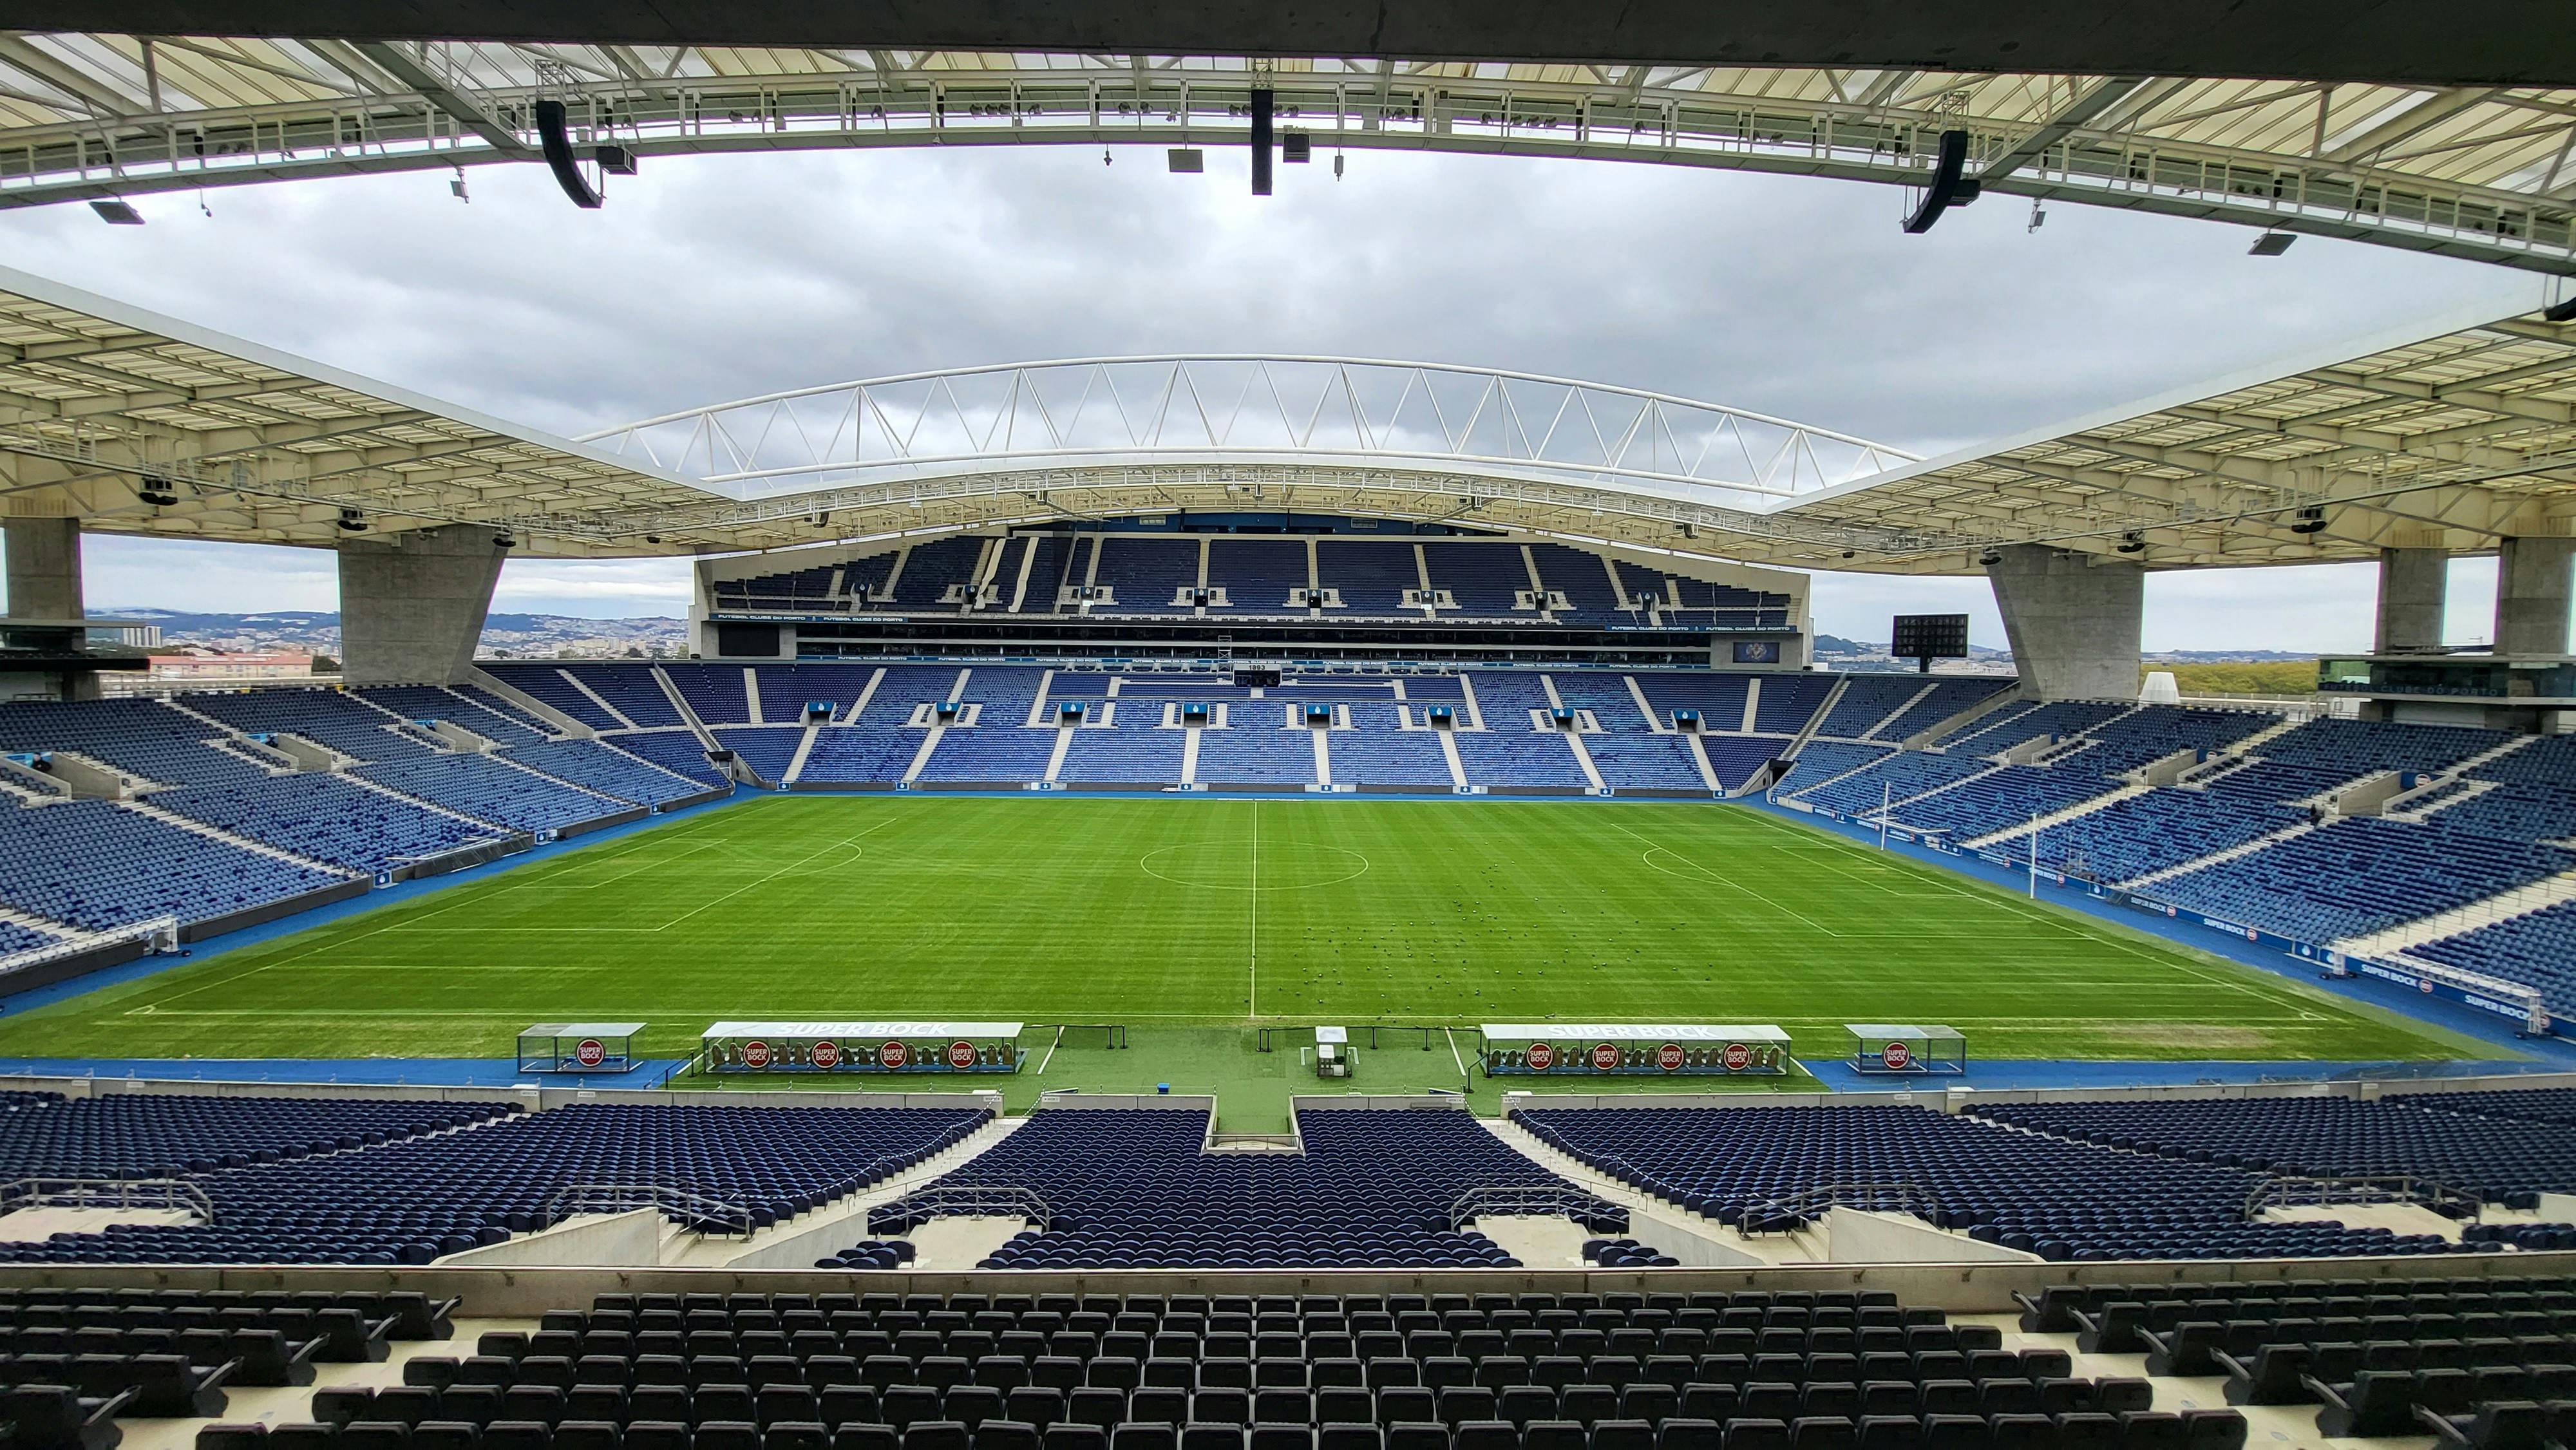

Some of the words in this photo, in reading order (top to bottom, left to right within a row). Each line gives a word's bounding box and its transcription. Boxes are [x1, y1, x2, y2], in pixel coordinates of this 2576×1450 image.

[2361, 964, 2390, 979] SUPER
[2391, 972, 2418, 987] BOCK
[2465, 995, 2499, 1012] SUPER
[775, 1023, 866, 1035] SUPER
[869, 1023, 951, 1035] BOCK
[1548, 1026, 1633, 1037] SUPER
[1636, 1026, 1718, 1037] BOCK
